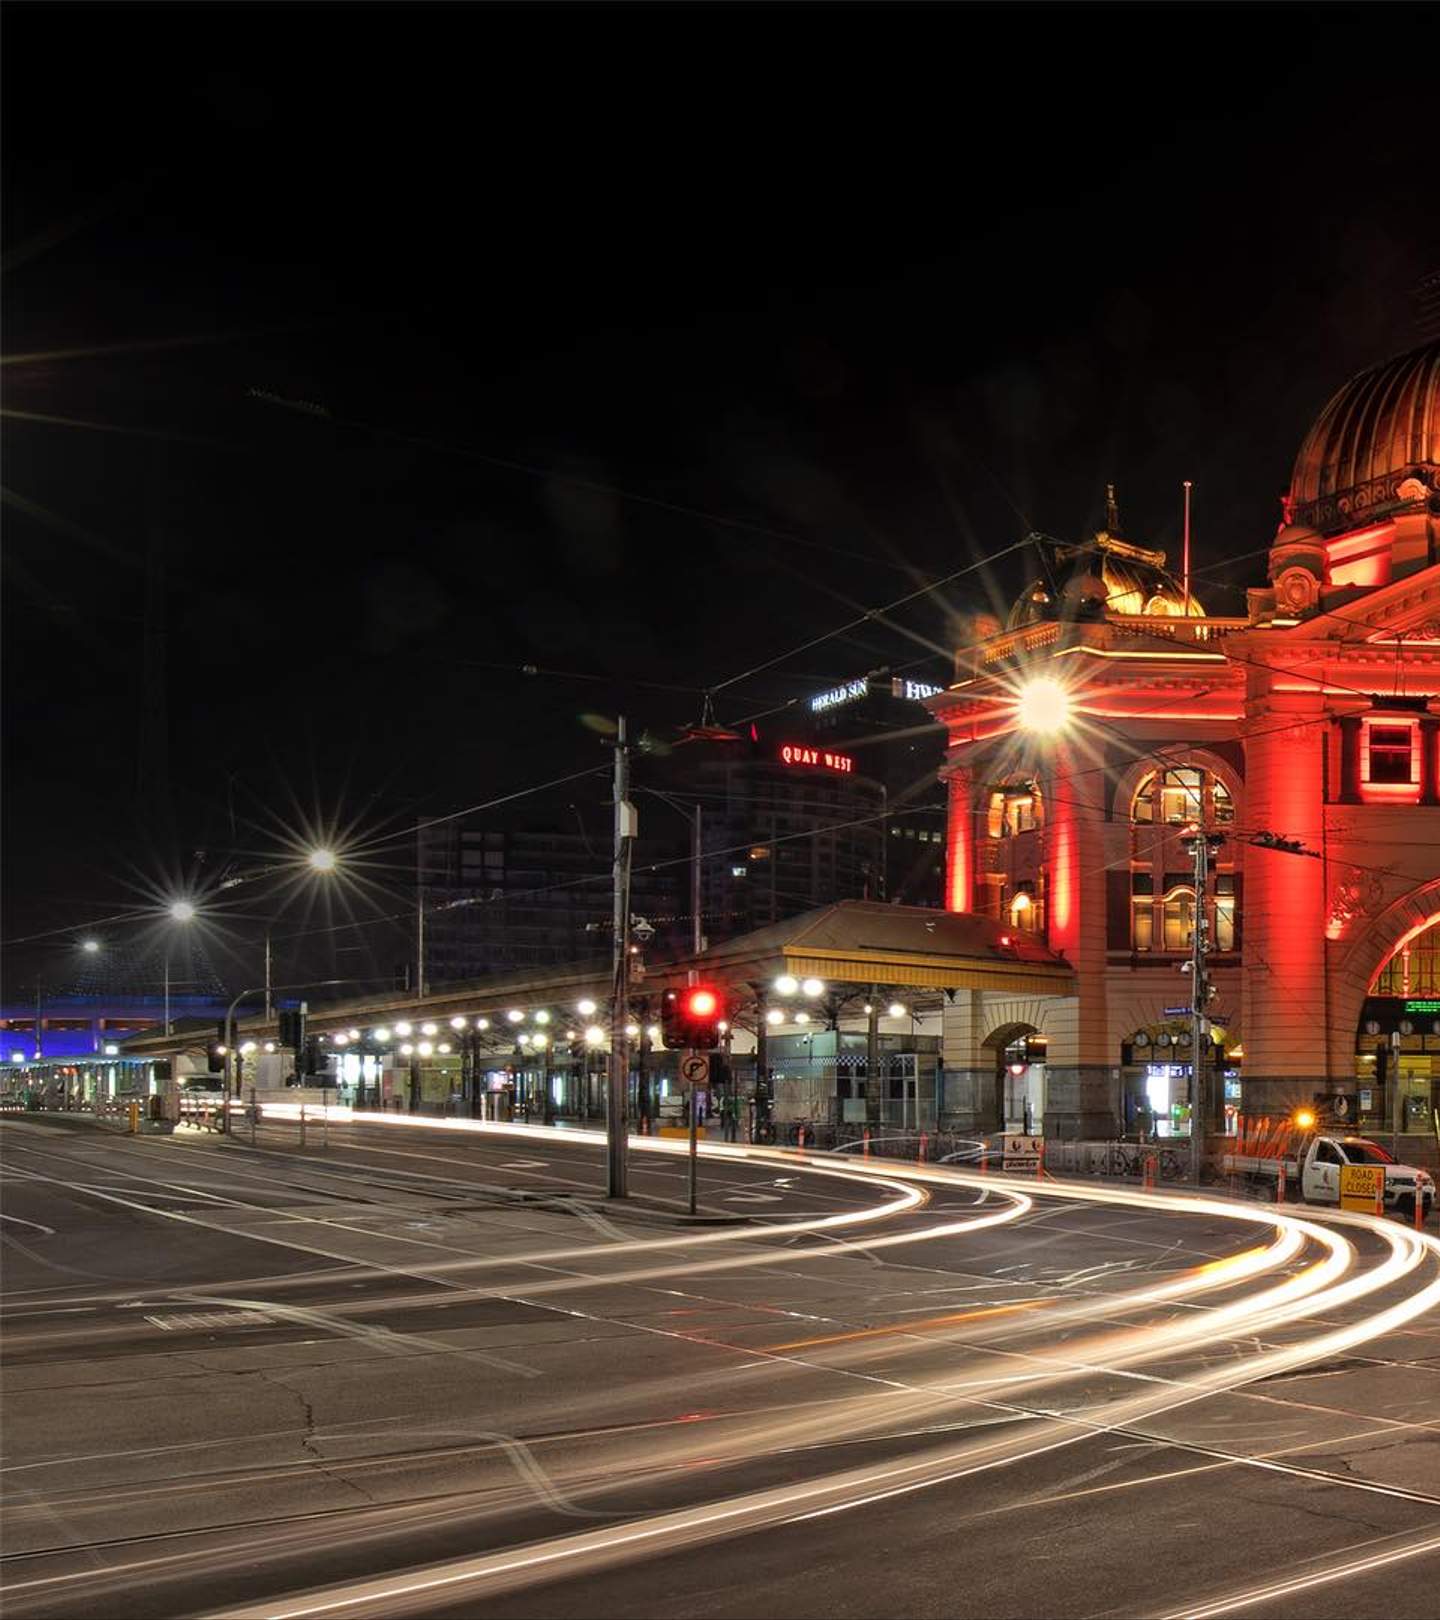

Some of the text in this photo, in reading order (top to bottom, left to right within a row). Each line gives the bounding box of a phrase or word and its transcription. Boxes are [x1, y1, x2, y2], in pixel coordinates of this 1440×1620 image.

[811, 677, 868, 712] HERALD SUN
[782, 746, 851, 772] QUAY WEST
[1351, 1168, 1374, 1180] ROAD
